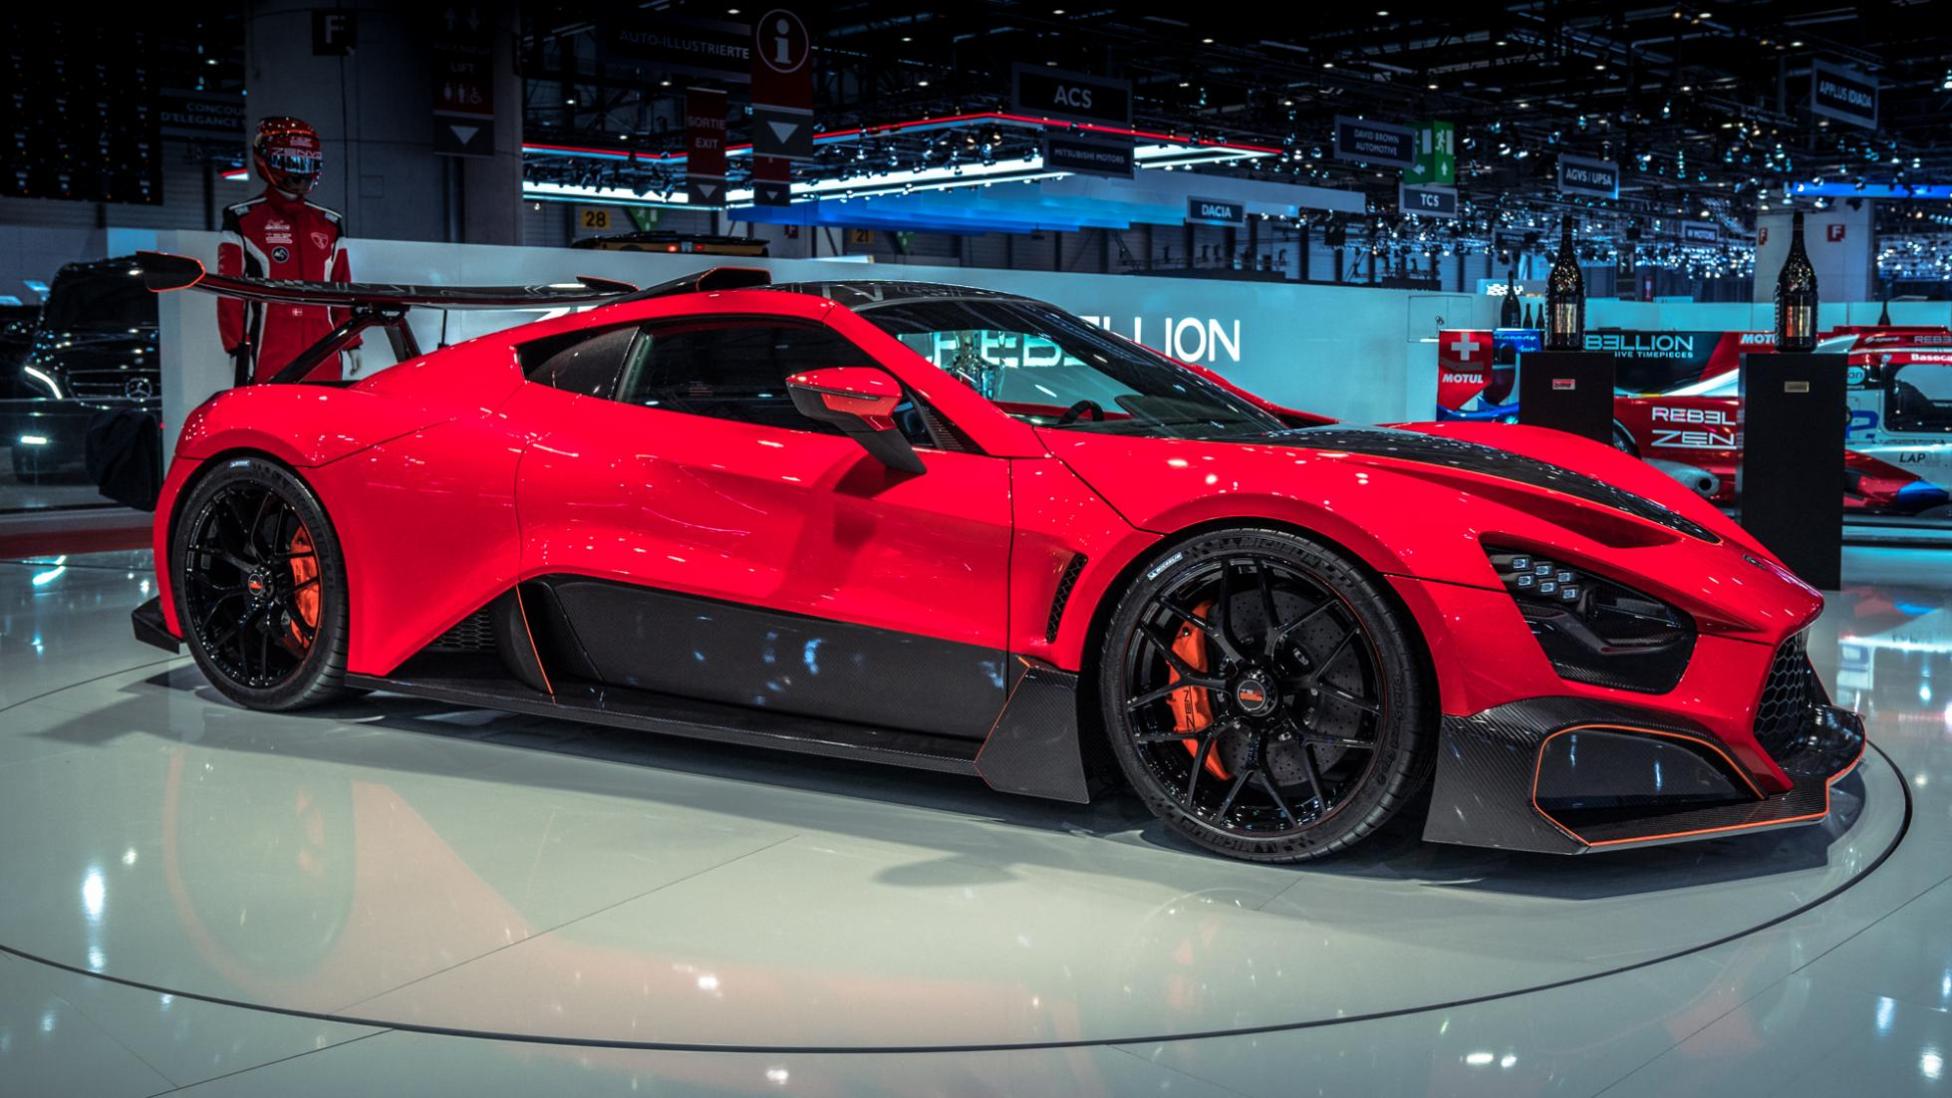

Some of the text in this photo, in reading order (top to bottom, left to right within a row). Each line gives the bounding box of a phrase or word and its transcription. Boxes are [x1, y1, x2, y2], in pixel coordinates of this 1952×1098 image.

[1054, 84, 1092, 109] ACS
[186, 102, 242, 115] CONCOU
[688, 115, 726, 130] SORTIE
[694, 136, 719, 149] EXIT
[1420, 193, 1440, 207] TCS
[1201, 203, 1232, 218] DACIA
[585, 210, 606, 228] 28
[1585, 334, 1694, 351] BELLION
[1914, 335, 1952, 344] REBE
[1637, 351, 1694, 359] TIMEPIECES
[1442, 374, 1484, 384] MOTUL
[1652, 406, 1737, 426] REBEL
[1651, 429, 1738, 450] ZEN
